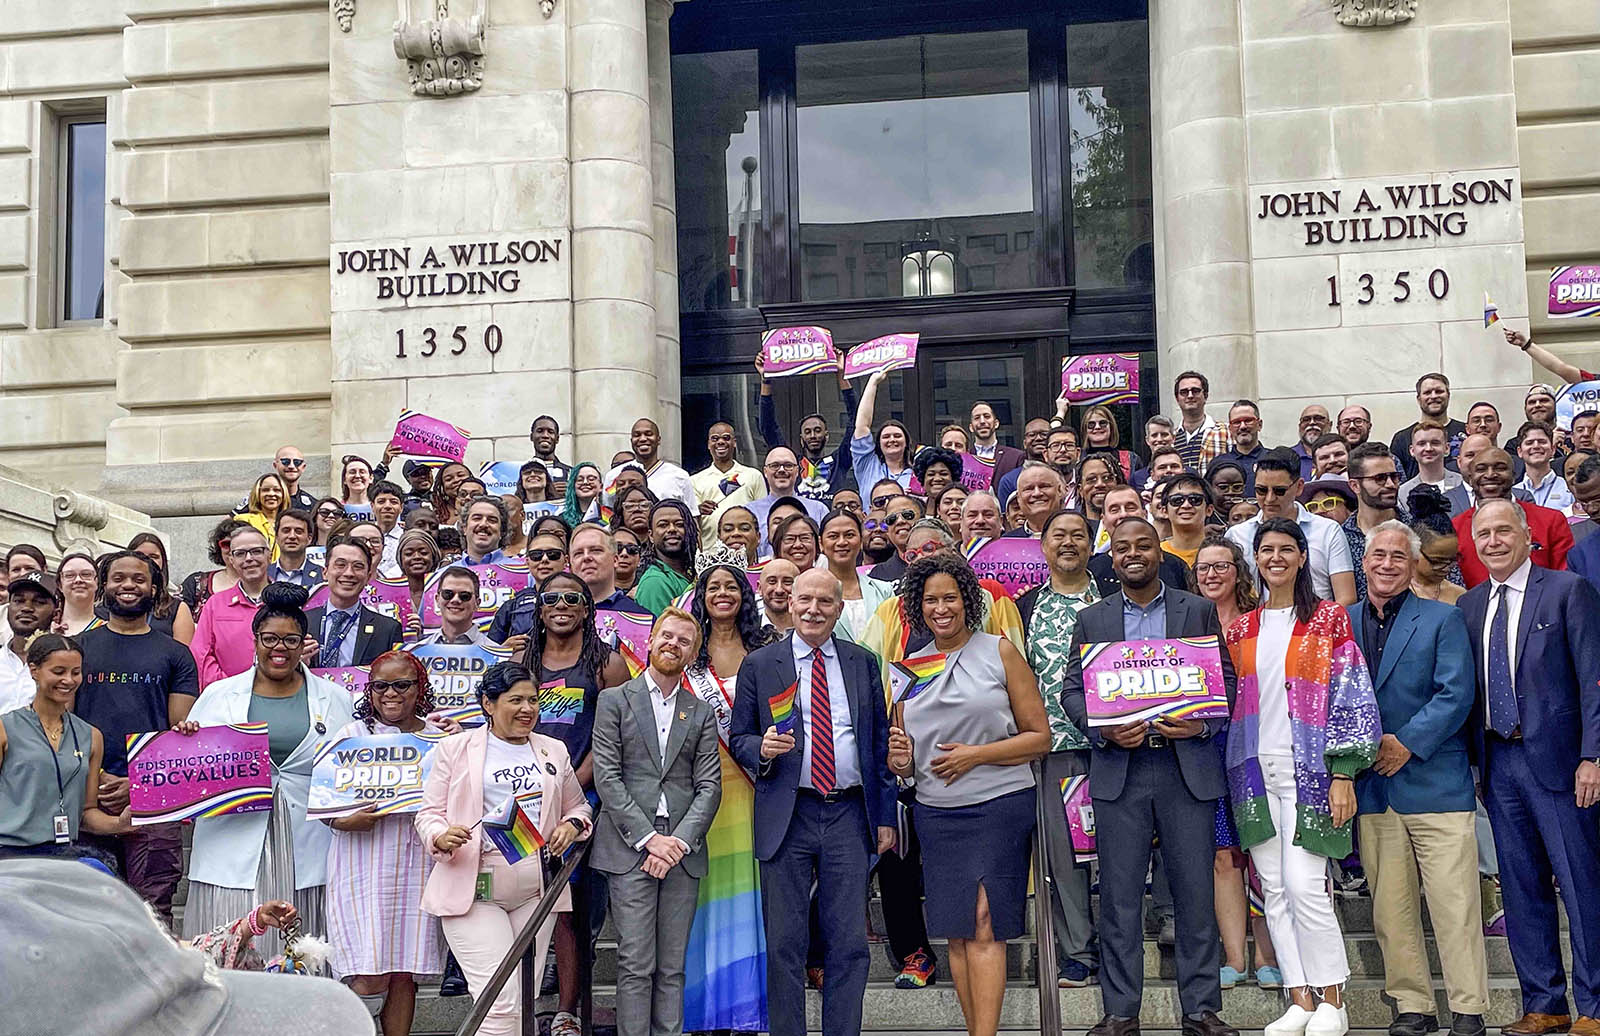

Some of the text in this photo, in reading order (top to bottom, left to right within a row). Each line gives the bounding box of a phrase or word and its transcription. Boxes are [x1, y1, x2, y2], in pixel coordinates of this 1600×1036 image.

[1258, 178, 1514, 219] JOHN A. WILSON
[1304, 211, 1468, 246] BUILDING
[337, 239, 562, 275] JOHN A. WILSON
[377, 270, 521, 300] BUILDING
[1557, 284, 1600, 304] PRID
[769, 343, 828, 363] PRIDE
[852, 345, 908, 367] PRIDE
[1069, 372, 1130, 392] PRIDE
[400, 430, 460, 457] #DCVALUES
[974, 561, 1049, 571] #DISTRICTOFP
[1113, 657, 1185, 669] DISTRICT OF
[346, 683, 360, 692] OF
[429, 675, 483, 695] RIDE
[1096, 666, 1209, 702] PRIDE
[138, 750, 260, 771] #DISTRICTOFPRIDE
[337, 746, 418, 764] WORLD
[140, 763, 260, 787] #DCVALUES
[336, 765, 422, 791] PRIDE
[492, 762, 542, 783] FROM
[354, 788, 396, 799] 2025
